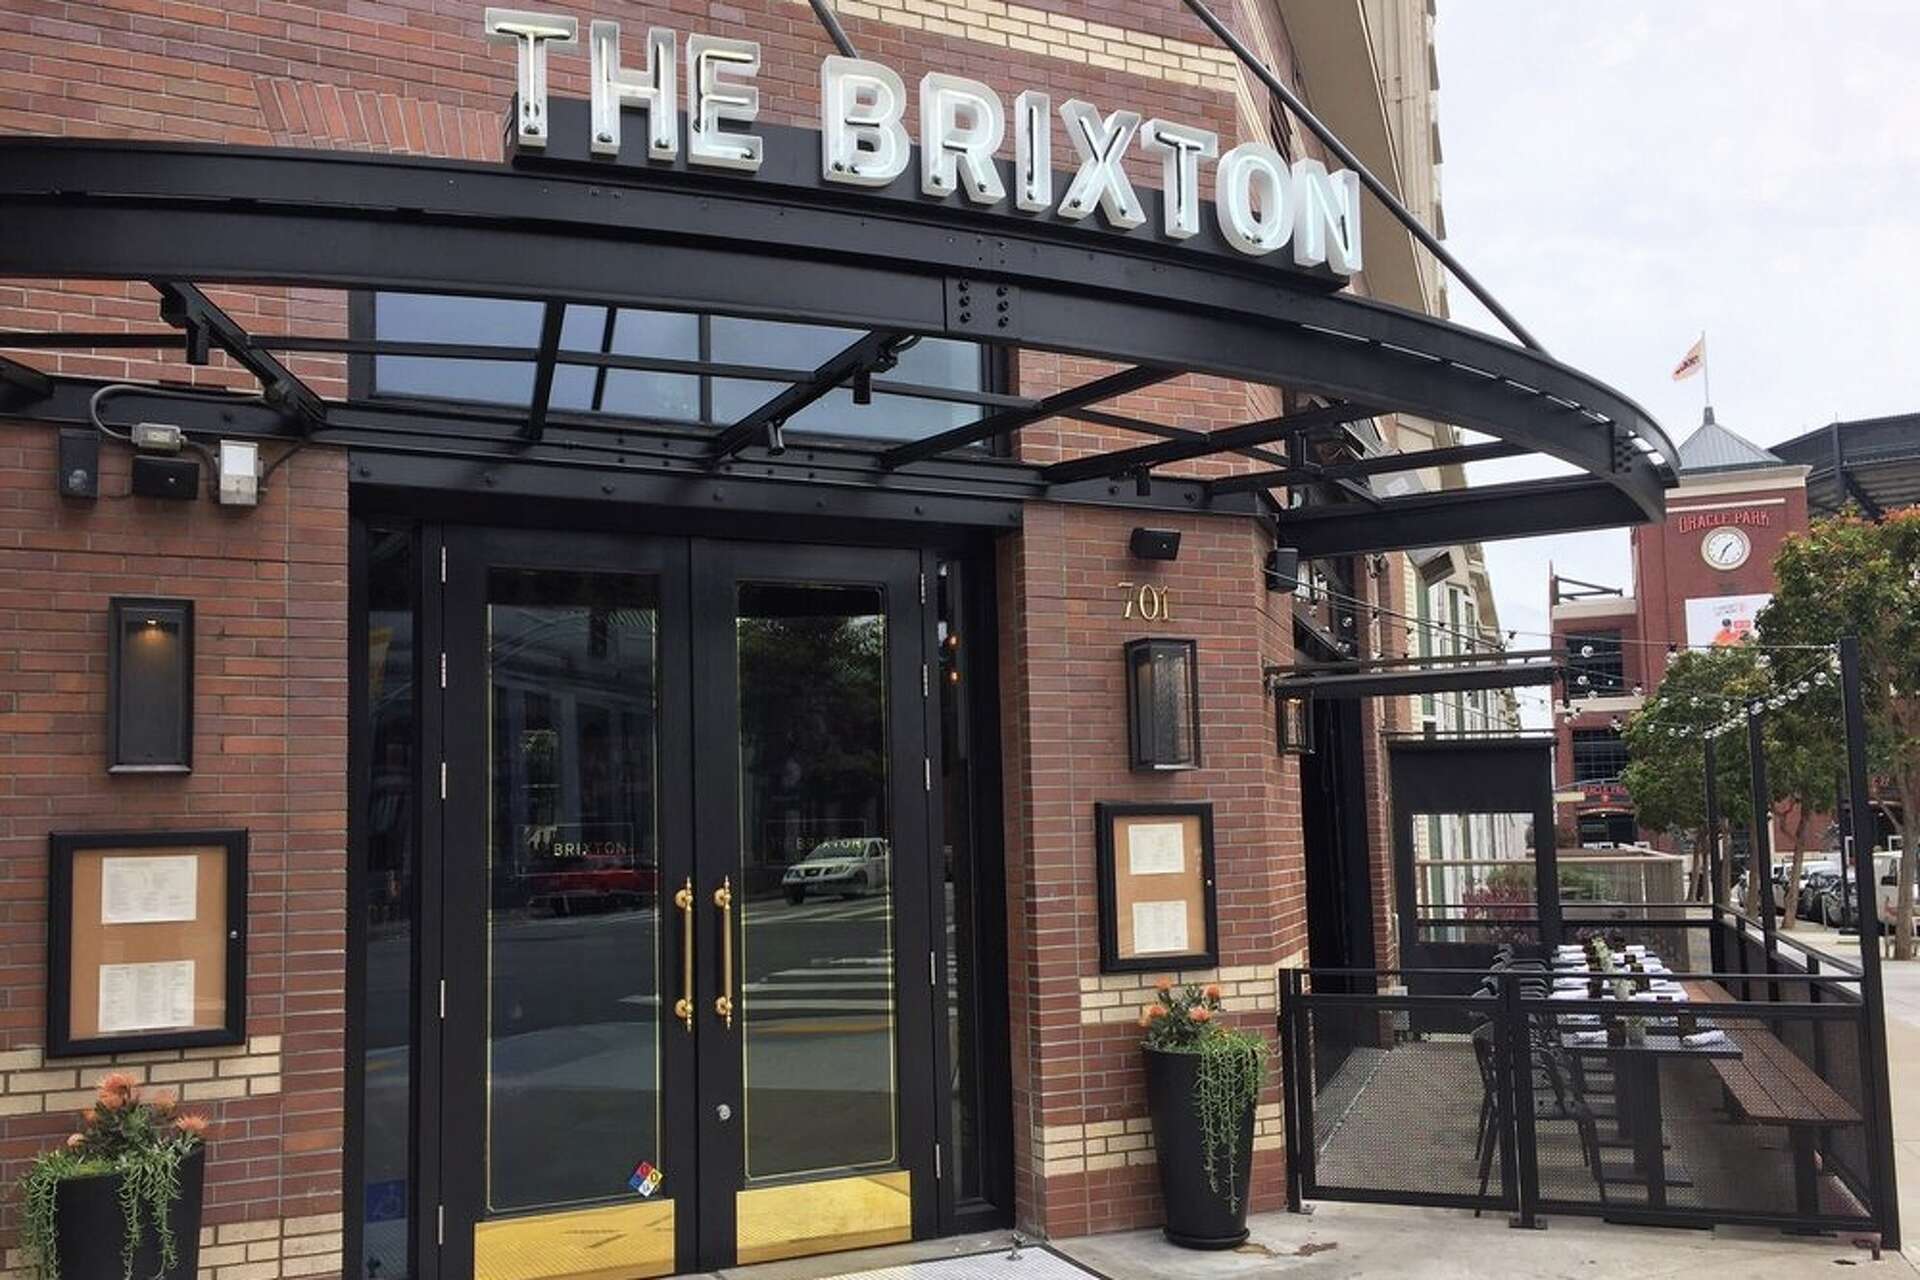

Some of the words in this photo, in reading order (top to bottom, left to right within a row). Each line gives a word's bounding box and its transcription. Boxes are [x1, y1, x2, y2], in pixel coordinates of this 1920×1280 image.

[485, 7, 763, 171] THE
[821, 55, 1362, 275] BRIXTON
[1679, 511, 1730, 533] ORACLE
[1735, 510, 1769, 527] PARK
[1118, 582, 1168, 620] 701
